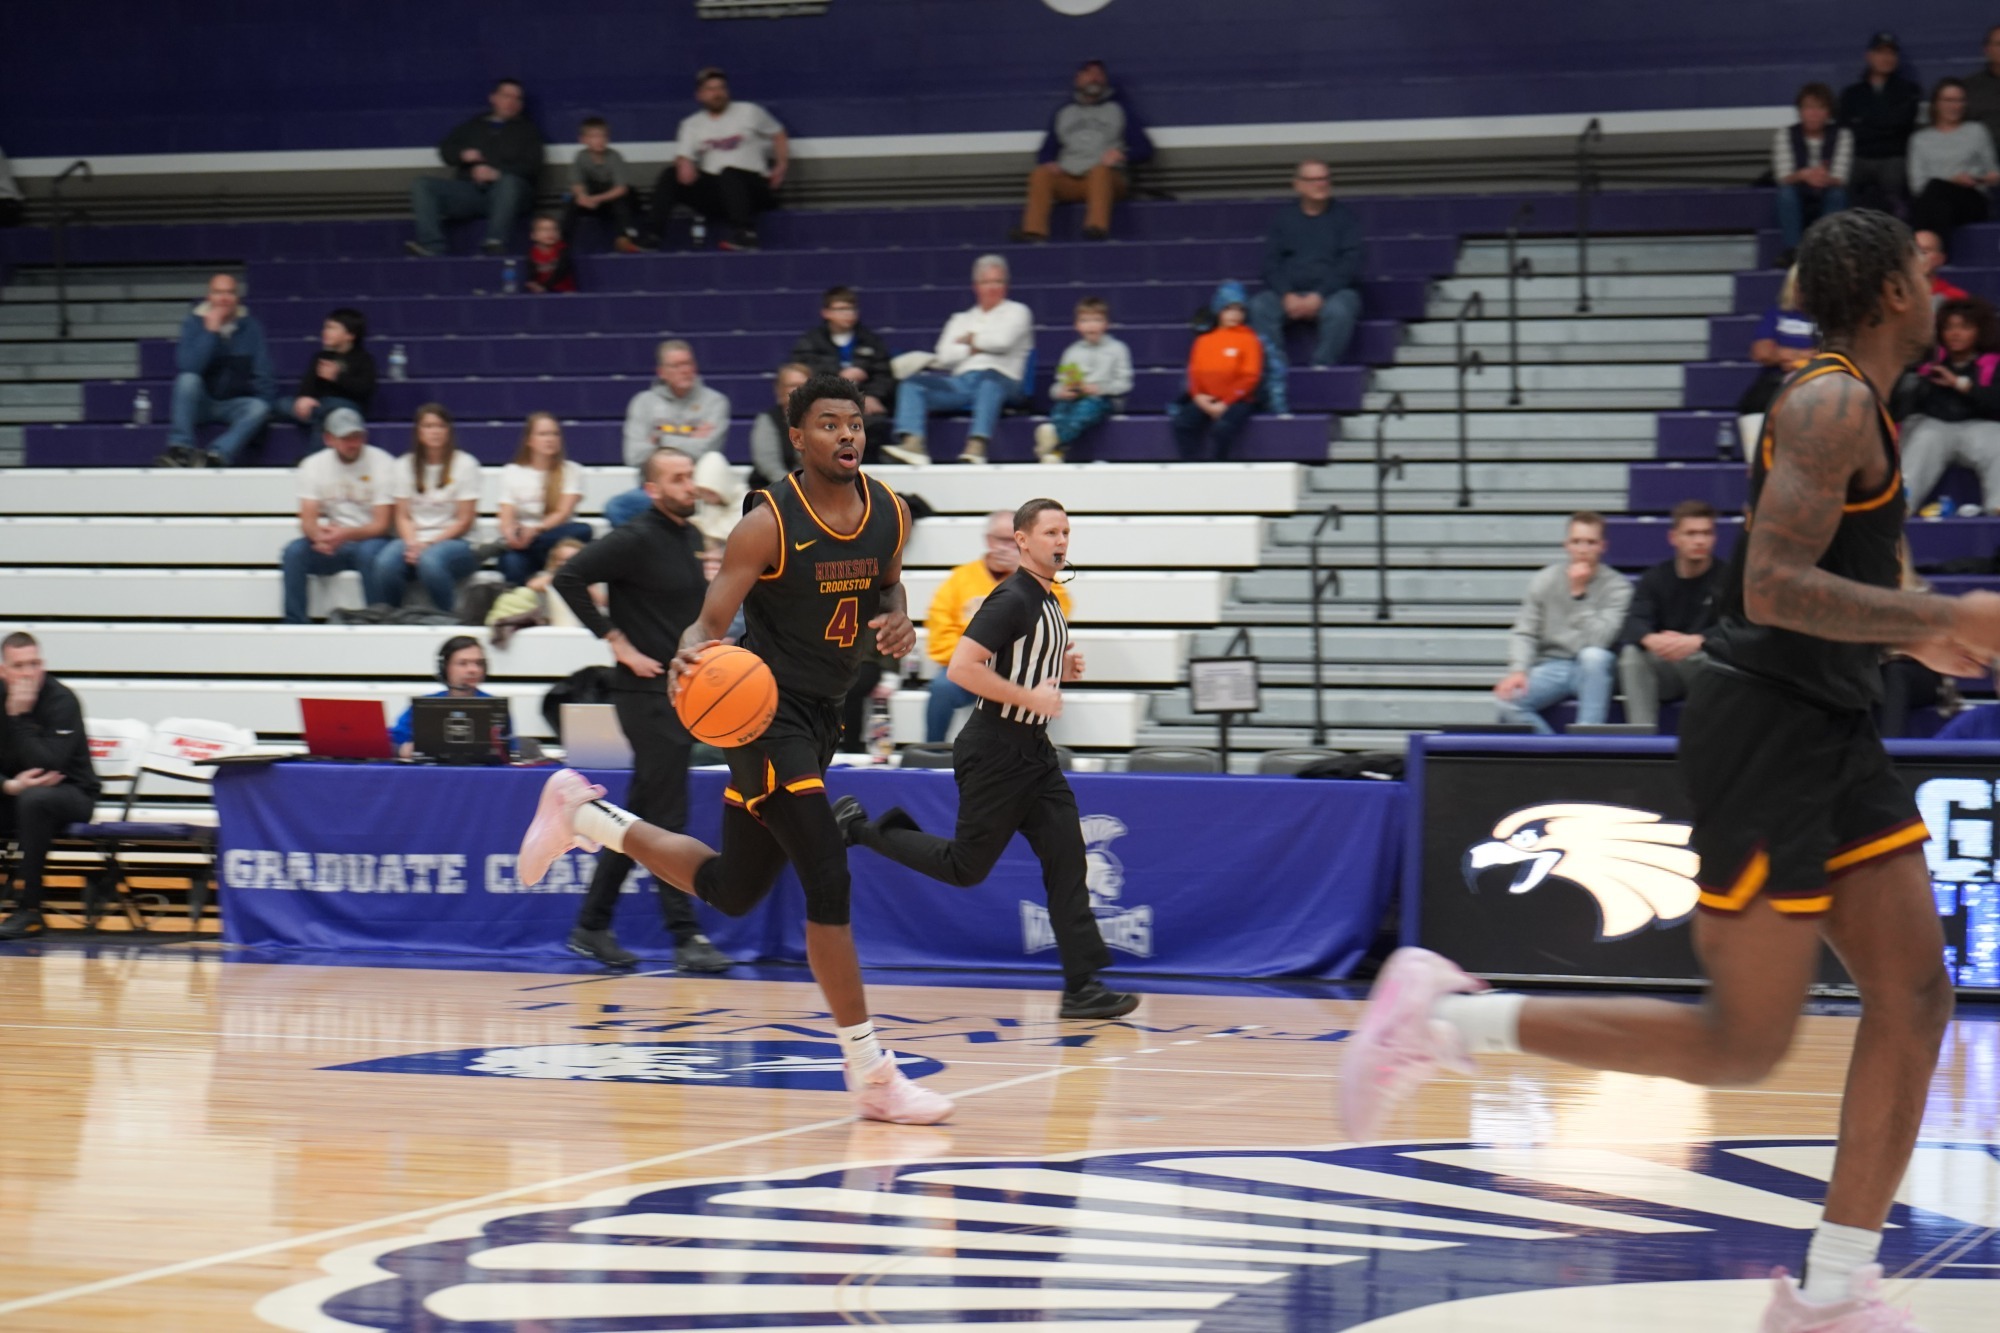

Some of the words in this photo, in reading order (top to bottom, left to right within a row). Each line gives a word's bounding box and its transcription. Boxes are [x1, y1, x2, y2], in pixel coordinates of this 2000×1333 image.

[815, 558, 879, 580] MINNESOTA
[820, 578, 871, 593] CROOKSTON
[825, 597, 858, 648] 4
[223, 848, 467, 894] GRADUATE
